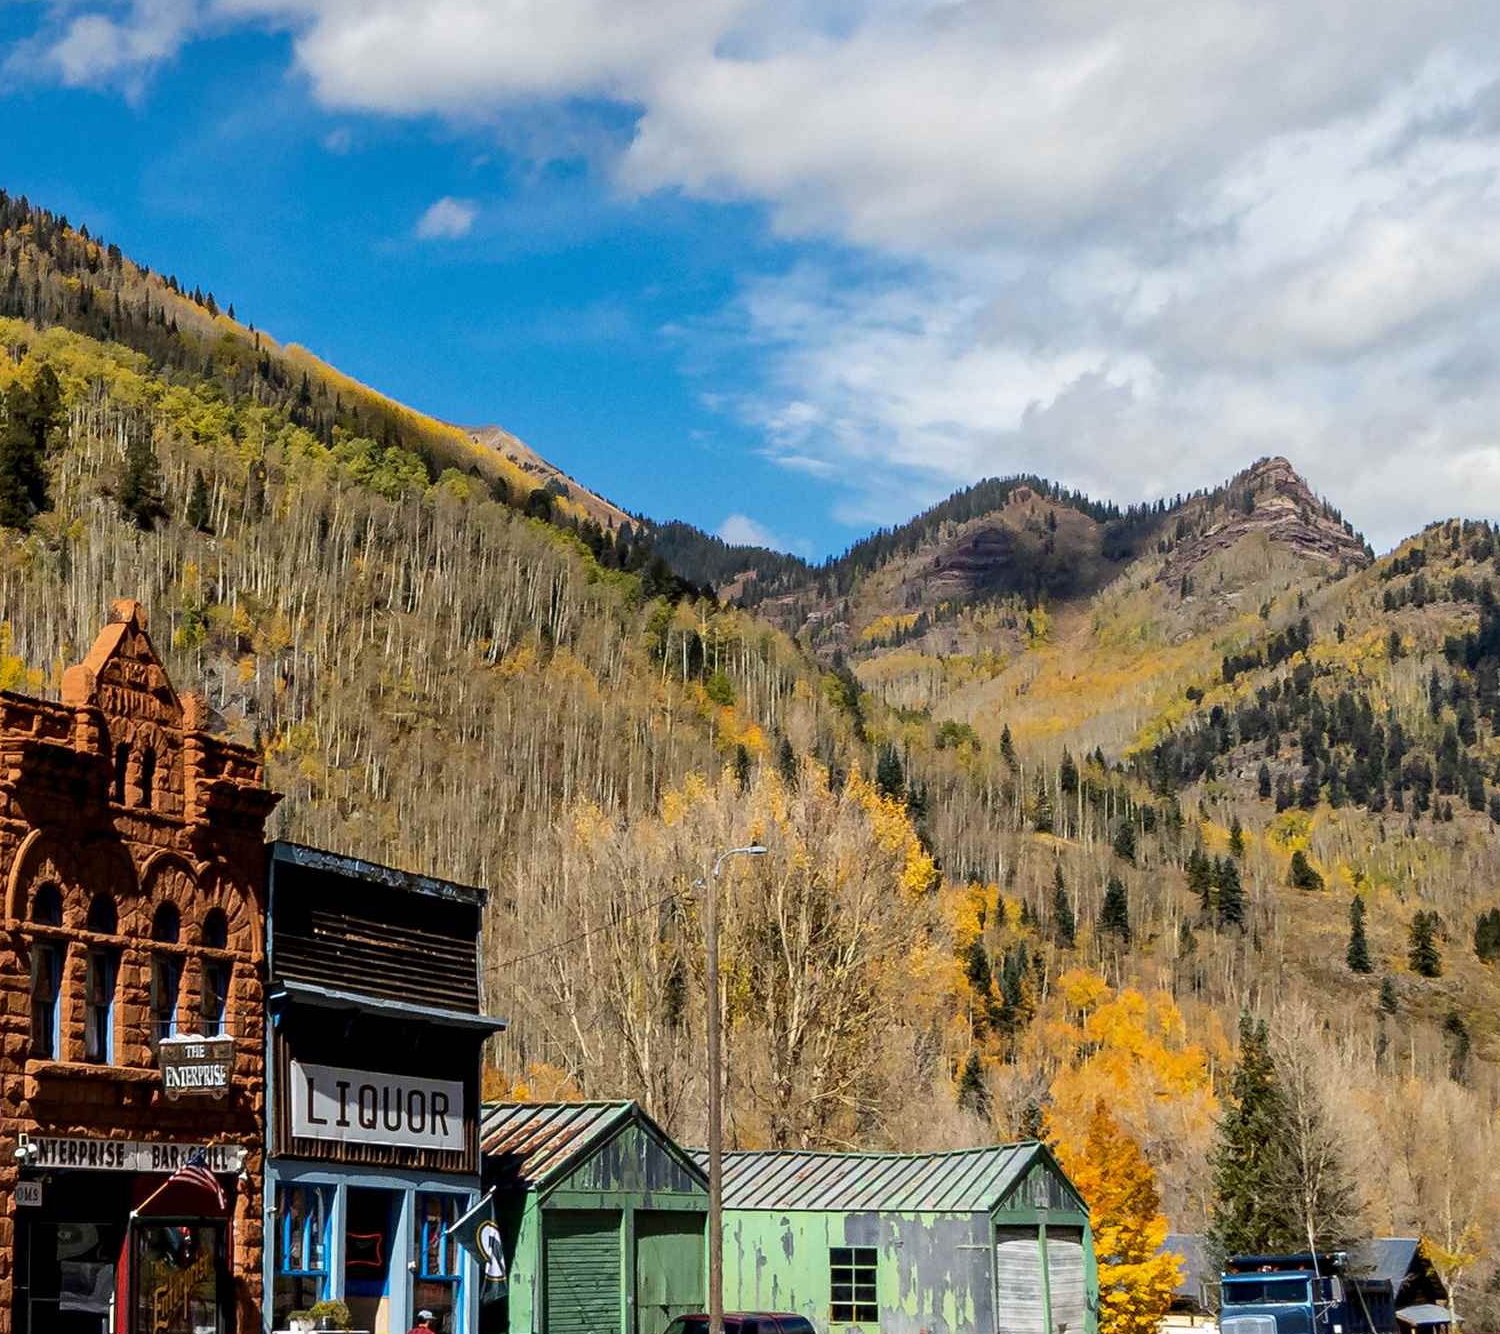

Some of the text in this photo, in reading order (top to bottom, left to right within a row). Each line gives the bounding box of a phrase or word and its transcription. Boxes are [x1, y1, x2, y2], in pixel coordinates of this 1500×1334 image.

[184, 1044, 205, 1058] THE
[165, 1064, 227, 1087] ENTERPRISE
[306, 1077, 449, 1136] LIQUOR
[29, 1137, 125, 1167] ENTERPRISE
[152, 1145, 179, 1169] BAR
[187, 1146, 228, 1170] GILL
